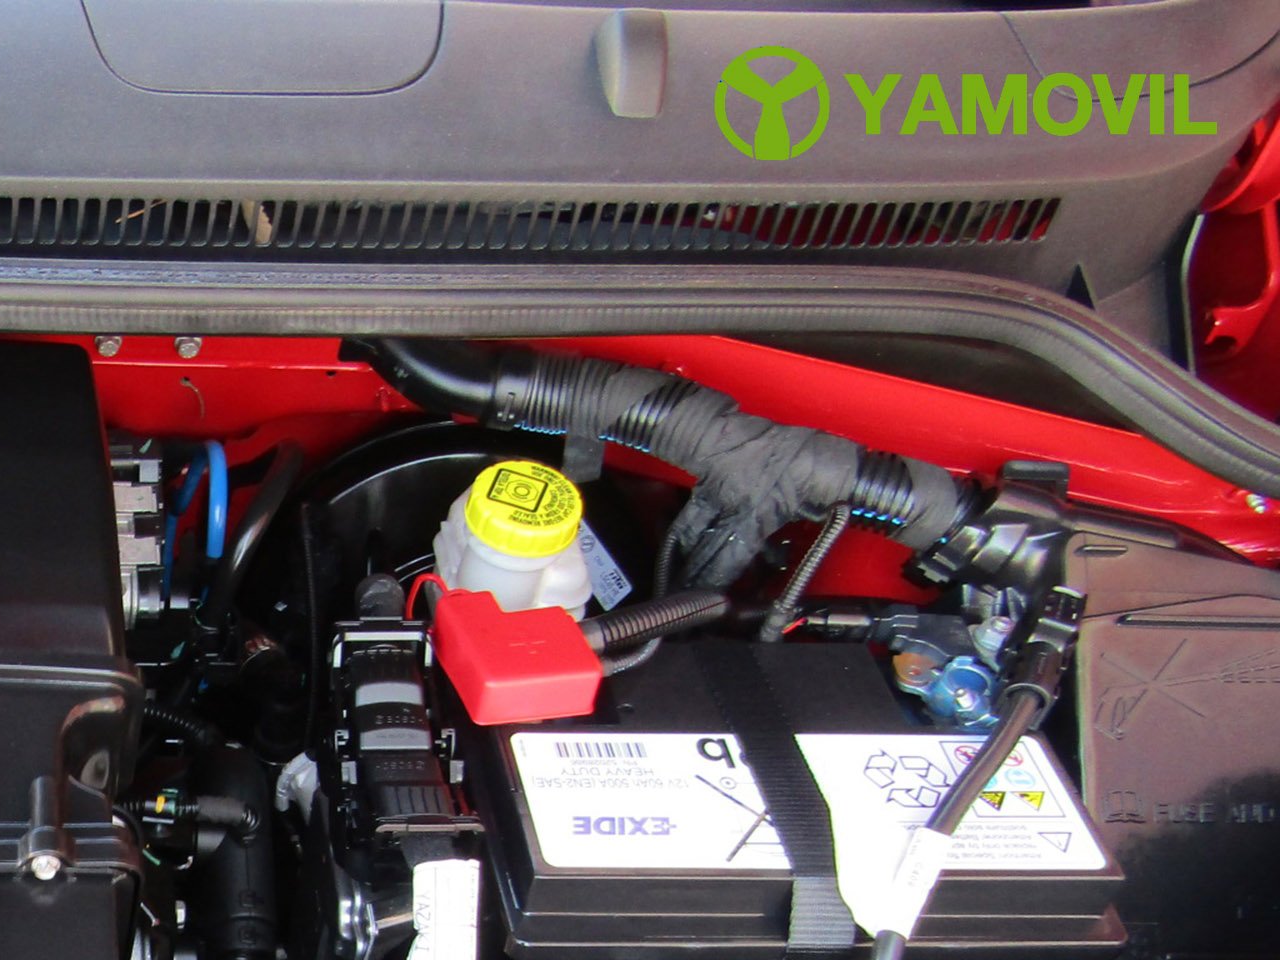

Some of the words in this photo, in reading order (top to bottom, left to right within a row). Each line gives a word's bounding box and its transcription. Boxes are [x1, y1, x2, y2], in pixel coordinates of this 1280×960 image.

[696, 738, 738, 768] b
[561, 767, 601, 776] DUTY
[605, 767, 654, 776] HEAVY
[1152, 802, 1217, 824] FUSE
[572, 816, 676, 836] EXIDE
[414, 890, 431, 952] YAZAKI
